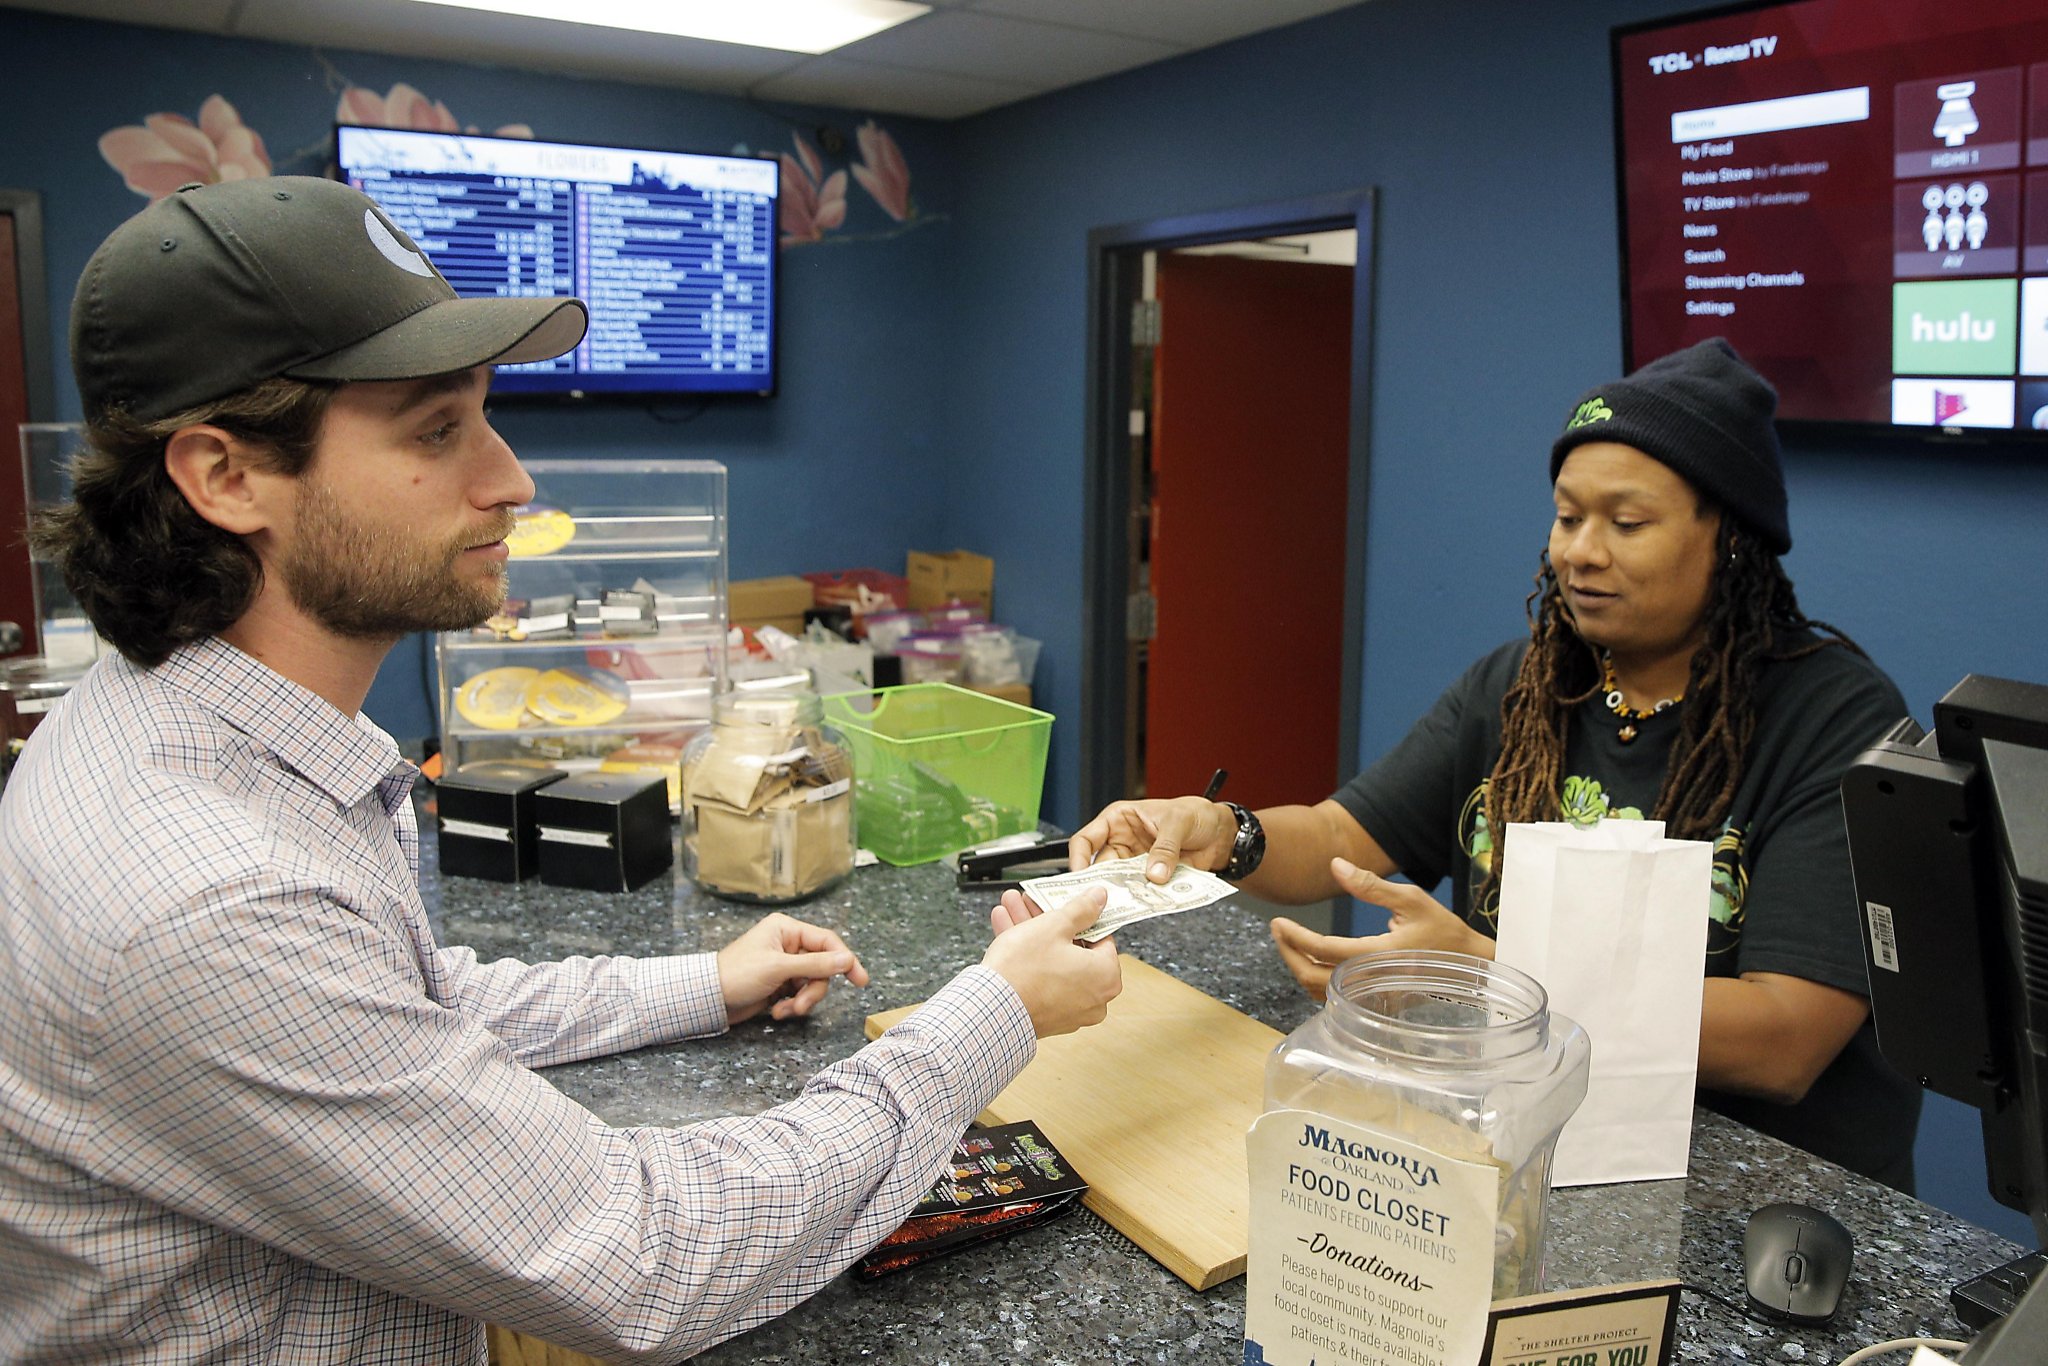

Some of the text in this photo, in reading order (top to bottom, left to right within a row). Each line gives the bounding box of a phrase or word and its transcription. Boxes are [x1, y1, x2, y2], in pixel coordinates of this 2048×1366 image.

[1649, 51, 1693, 75] TCL
[1750, 35, 1778, 58] TV
[1681, 144, 1700, 161] My
[1682, 170, 1718, 186] Movie
[1718, 167, 1753, 182] Store
[1683, 197, 1702, 212] TV
[1702, 196, 1736, 211] Store
[1683, 224, 1718, 238] News
[1684, 248, 1726, 264] Search
[1685, 271, 1805, 290] Streaming Channels
[1686, 300, 1735, 316] Settings
[1911, 311, 1995, 342] hulu
[1299, 1124, 1440, 1186] MAGNOLIA
[1332, 1156, 1404, 1191] OAKLAND
[1289, 1164, 1450, 1237] FOOD CLOSET
[1281, 1189, 1456, 1264] PATIENTS FEEDING PATIENTS
[1282, 1254, 1447, 1329] Please help us to support our
[1282, 1275, 1445, 1351] local community. Magnolia's
[1275, 1293, 1435, 1366] food closet is made available
[1292, 1324, 1378, 1366] patients & their
[1521, 1328, 1638, 1351] THE SHELTER PROJECT
[1608, 1345, 1648, 1366] YOU
